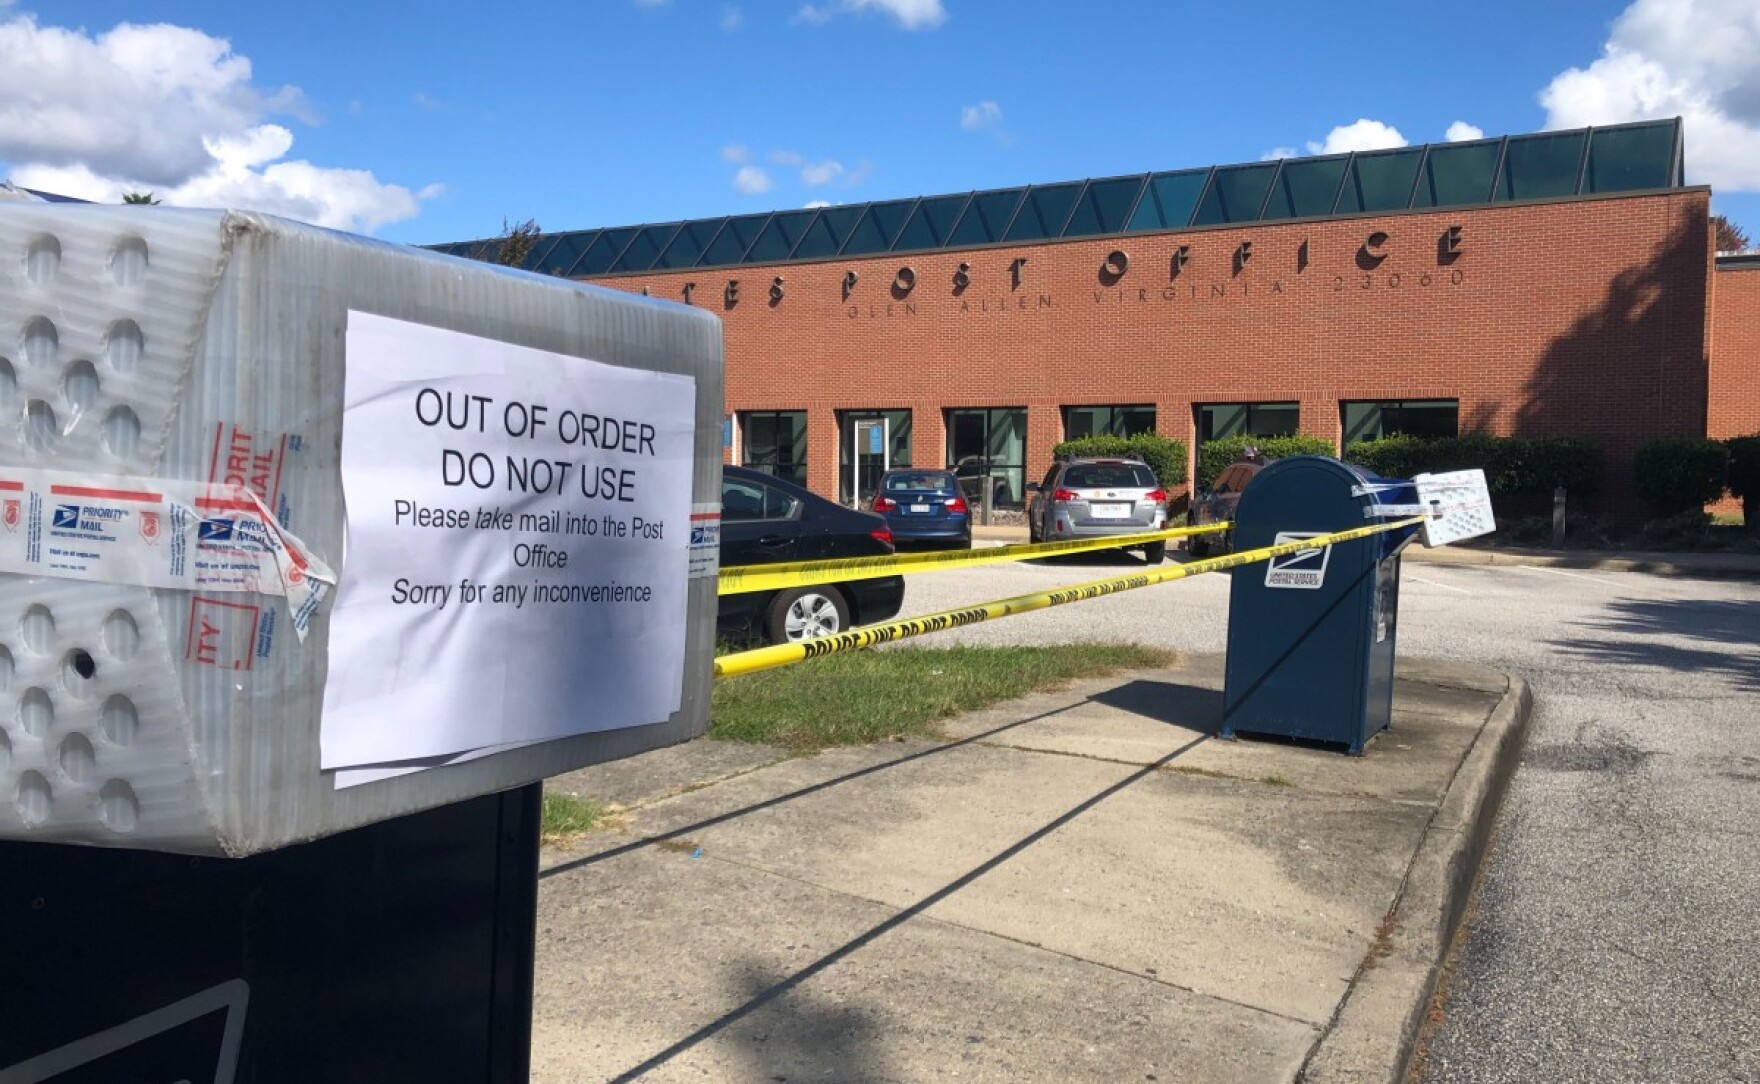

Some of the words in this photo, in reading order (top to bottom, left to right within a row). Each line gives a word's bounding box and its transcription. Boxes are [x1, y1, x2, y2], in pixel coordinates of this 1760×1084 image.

[643, 275, 785, 305] TES
[844, 258, 1028, 294] POST
[1104, 226, 1462, 276] OFFICE
[848, 303, 916, 319] GLEN
[960, 295, 1051, 312] ALLEN
[1093, 281, 1283, 304] VIRGINIA
[1333, 269, 1464, 292] 23060
[415, 387, 493, 433] OUT
[503, 401, 549, 440] OF
[558, 410, 656, 456] ORDER
[442, 449, 495, 489] DO
[506, 455, 573, 495] NOT
[580, 464, 636, 503] USE
[80, 520, 104, 532] MAIL
[394, 499, 470, 530] Please
[474, 506, 513, 531] take
[519, 510, 560, 534] mail
[565, 511, 598, 536] into
[603, 514, 627, 538] the
[631, 516, 664, 540] Post
[513, 543, 568, 569] Office
[391, 578, 452, 610] Sorry
[459, 578, 487, 602] for
[492, 583, 526, 609] any
[533, 579, 652, 603] inconvenience
